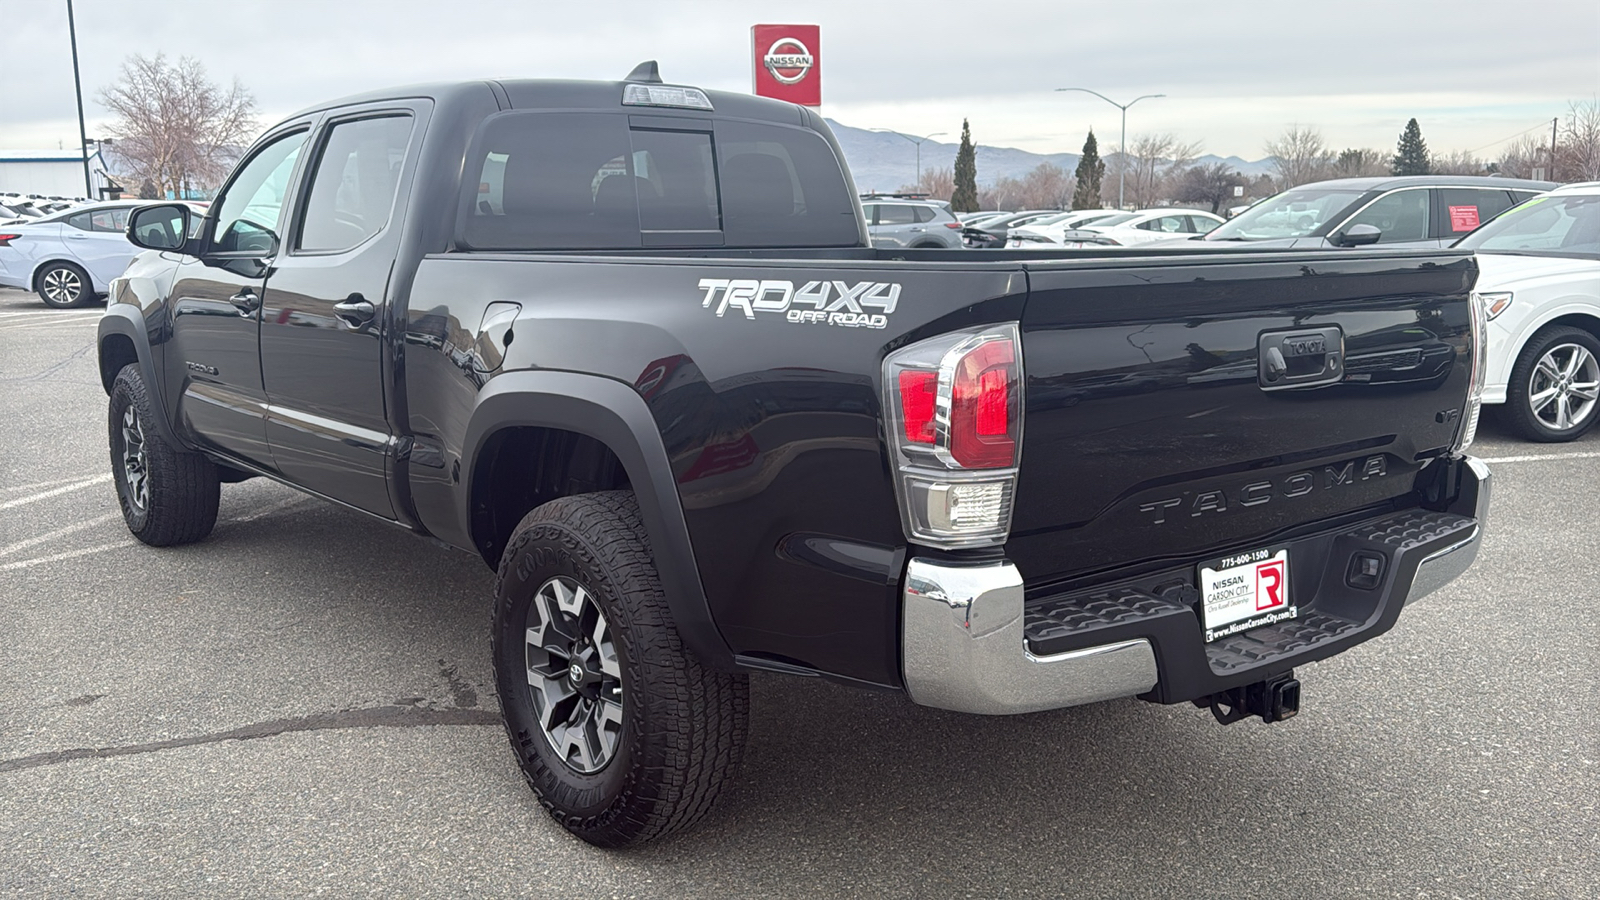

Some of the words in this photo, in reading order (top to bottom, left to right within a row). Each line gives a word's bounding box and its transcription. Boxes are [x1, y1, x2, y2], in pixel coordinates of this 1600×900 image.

[769, 57, 809, 65] NISSAN
[698, 278, 795, 320] TRD
[792, 280, 902, 314] 4X4
[786, 309, 828, 324] OFF
[827, 312, 888, 329] ROAD
[1290, 340, 1326, 355] TOYOTA
[1139, 454, 1388, 525] TACOMA
[1221, 549, 1269, 568] 775-600-1500
[1212, 575, 1244, 590] NISSAN
[1207, 588, 1235, 603] CARSON
[1235, 584, 1249, 596] CITY
[1213, 611, 1290, 639] www.NissanCarsonCity.com
